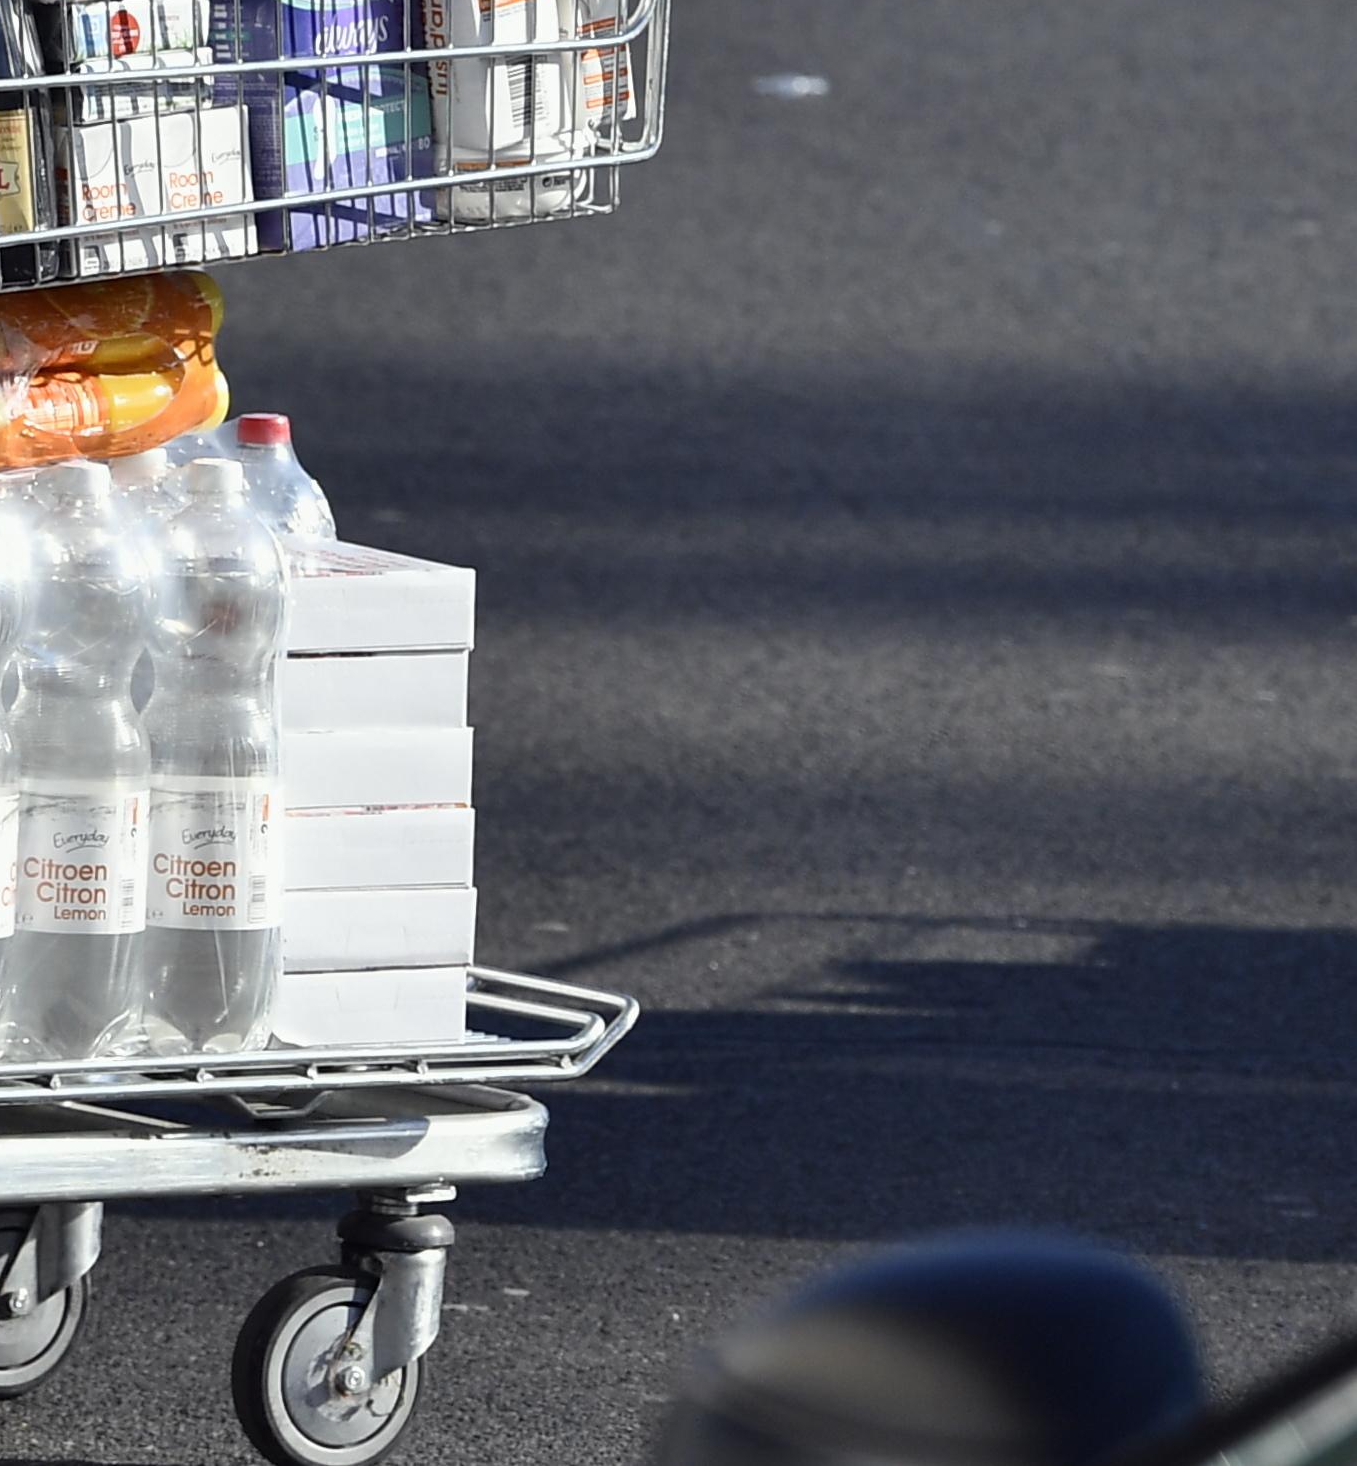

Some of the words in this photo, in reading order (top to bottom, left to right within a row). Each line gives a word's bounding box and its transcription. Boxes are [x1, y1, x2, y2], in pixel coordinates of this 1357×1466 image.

[169, 169, 214, 189] Room
[82, 181, 128, 203] Room
[53, 828, 110, 851] Everyday
[182, 825, 236, 847] Everyday
[23, 856, 108, 882] Citroen
[153, 852, 237, 878] Citroen
[36, 880, 107, 905] Citron
[166, 877, 236, 901] Citron
[54, 905, 107, 921] Lemon
[182, 901, 236, 917] Lemon
